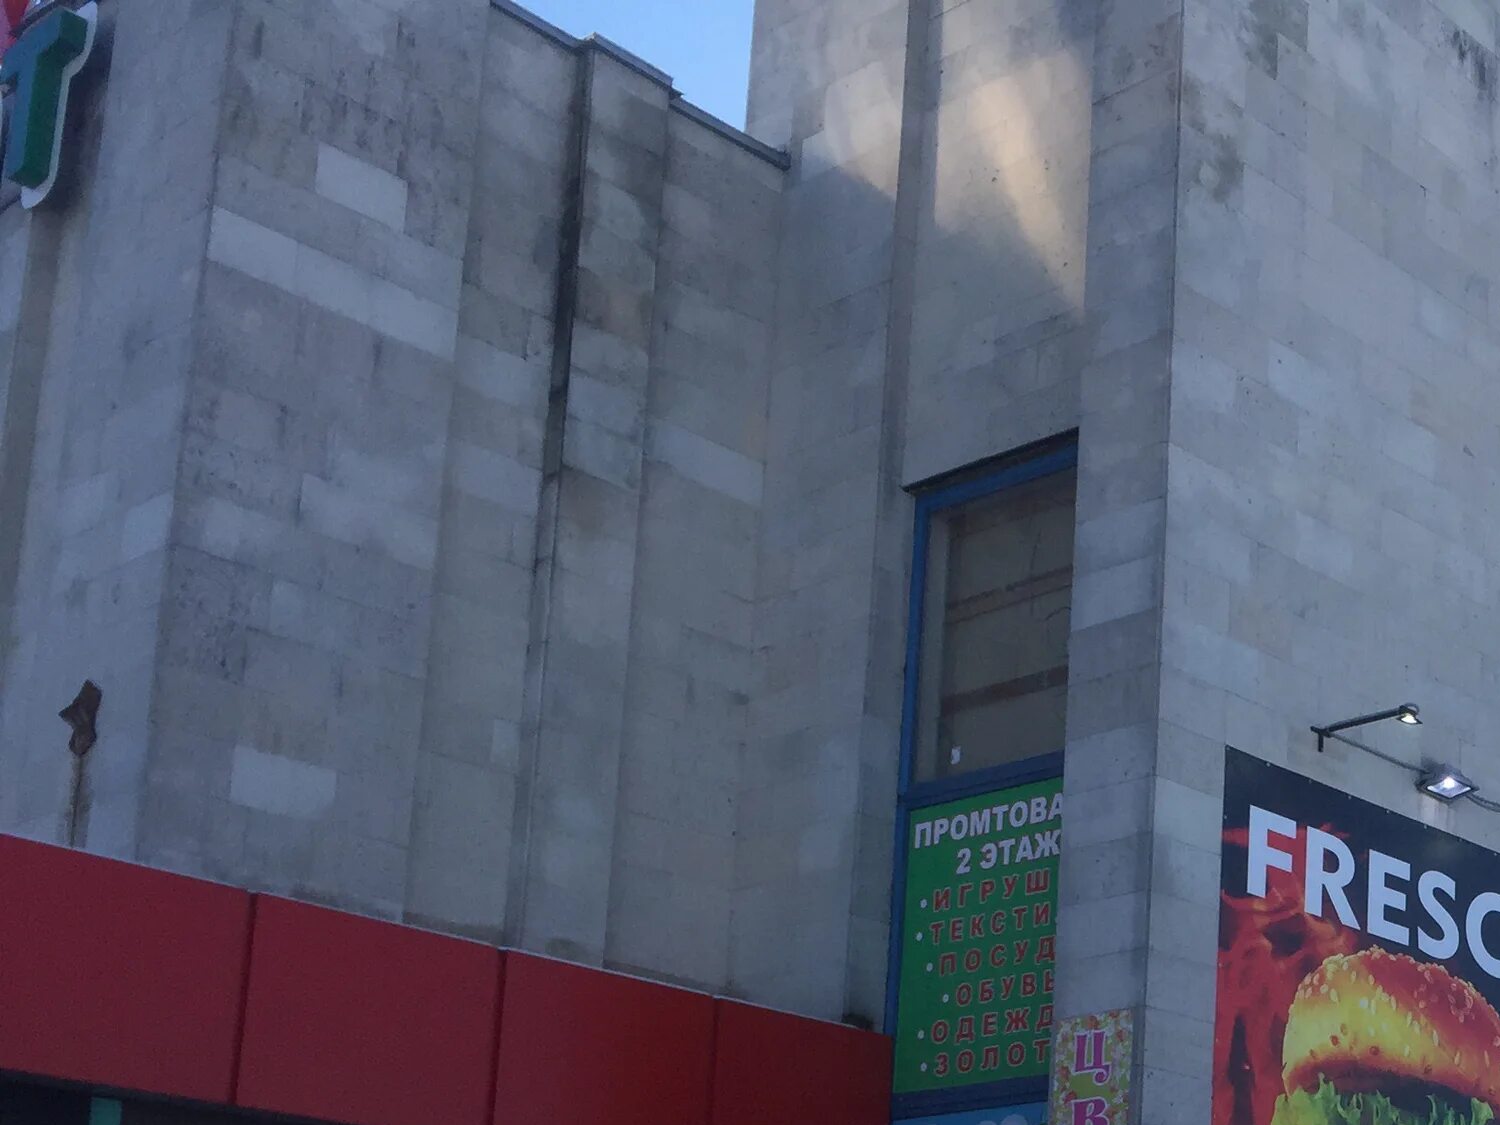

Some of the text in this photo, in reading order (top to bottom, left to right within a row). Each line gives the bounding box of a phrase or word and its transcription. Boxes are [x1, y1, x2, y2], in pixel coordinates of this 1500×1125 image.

[956, 830, 1061, 874] 2 ЭТАЖ
[933, 869, 1049, 911] ИГРУШ
[930, 902, 1050, 943] ТЕКСТИ
[939, 936, 1055, 976] ПОСУД
[931, 1005, 1053, 1045] ОДЕЖД
[934, 1040, 1050, 1077] ЗОЛОТ
